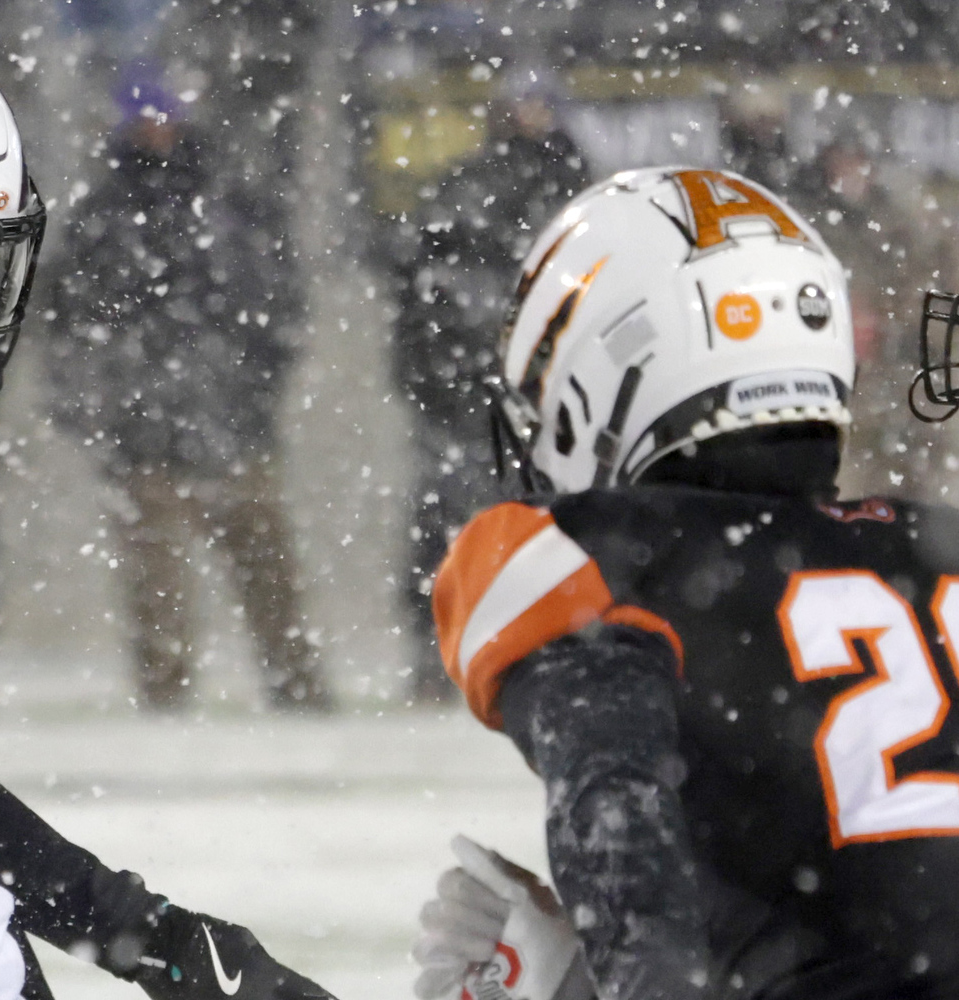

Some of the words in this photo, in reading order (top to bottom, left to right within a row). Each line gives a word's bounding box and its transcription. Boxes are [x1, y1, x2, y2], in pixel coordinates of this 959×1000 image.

[675, 169, 825, 262] A
[726, 304, 754, 325] DC
[774, 567, 959, 851] 2
